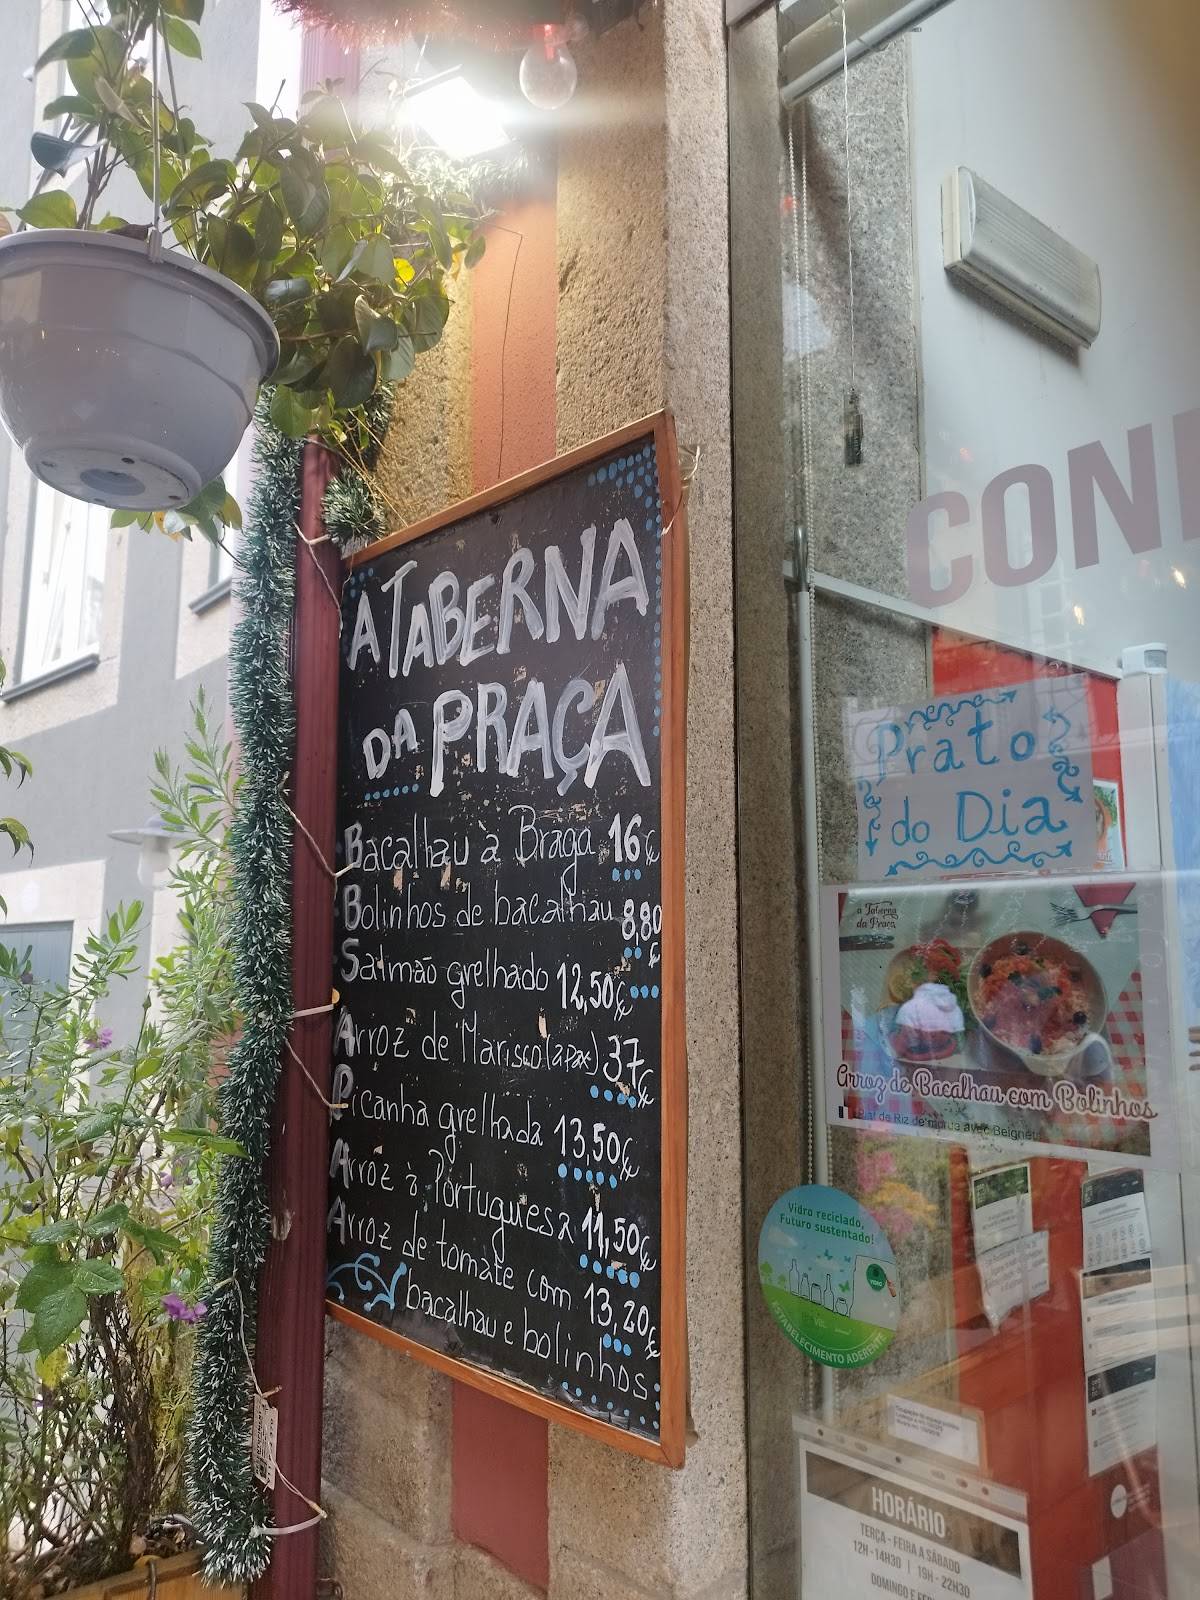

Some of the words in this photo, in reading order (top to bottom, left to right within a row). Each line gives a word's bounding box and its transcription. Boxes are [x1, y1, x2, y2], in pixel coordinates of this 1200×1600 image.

[347, 591, 380, 671] A
[381, 518, 649, 678] TABERNA
[362, 708, 418, 779] DA
[429, 661, 652, 797] PRAÇA
[873, 709, 1036, 785] Prato
[344, 812, 470, 871] Bacalhau
[508, 805, 596, 896] Braga
[891, 796, 930, 846] do
[956, 788, 1069, 843] Dia
[343, 883, 446, 931] Bolinhos
[456, 882, 484, 928] de
[495, 877, 615, 926] bacalhau
[621, 898, 662, 946] 8,80
[340, 937, 437, 983] Salmão
[446, 947, 549, 1009] grelhado
[333, 1008, 409, 1058] Arroz
[422, 1010, 449, 1061] de
[332, 1064, 429, 1127] Picanha
[439, 1092, 543, 1163] grelhada
[889, 1068, 912, 1094] de
[914, 1070, 1004, 1104] Bacalhau
[1008, 1088, 1050, 1110] com
[1054, 1081, 1158, 1119] Bolinhos
[329, 1137, 394, 1191] Arroz
[405, 1162, 418, 1197] à
[428, 1149, 574, 1264] Portuguesa
[780, 1213, 812, 1230] Futuro
[814, 1224, 874, 1244] sustentado!
[788, 1202, 813, 1217] Vidro
[326, 1195, 392, 1251] Arroz
[402, 1210, 427, 1260] de
[436, 1218, 514, 1290] tomate
[526, 1268, 572, 1311] com
[405, 1268, 497, 1339] bacalhau
[503, 1323, 514, 1346] e
[523, 1307, 648, 1400] bolinhos
[771, 1300, 844, 1364] ESTABELECIMENTO
[846, 1331, 888, 1364] ADERENTE
[871, 1486, 946, 1538] HORÁRIO
